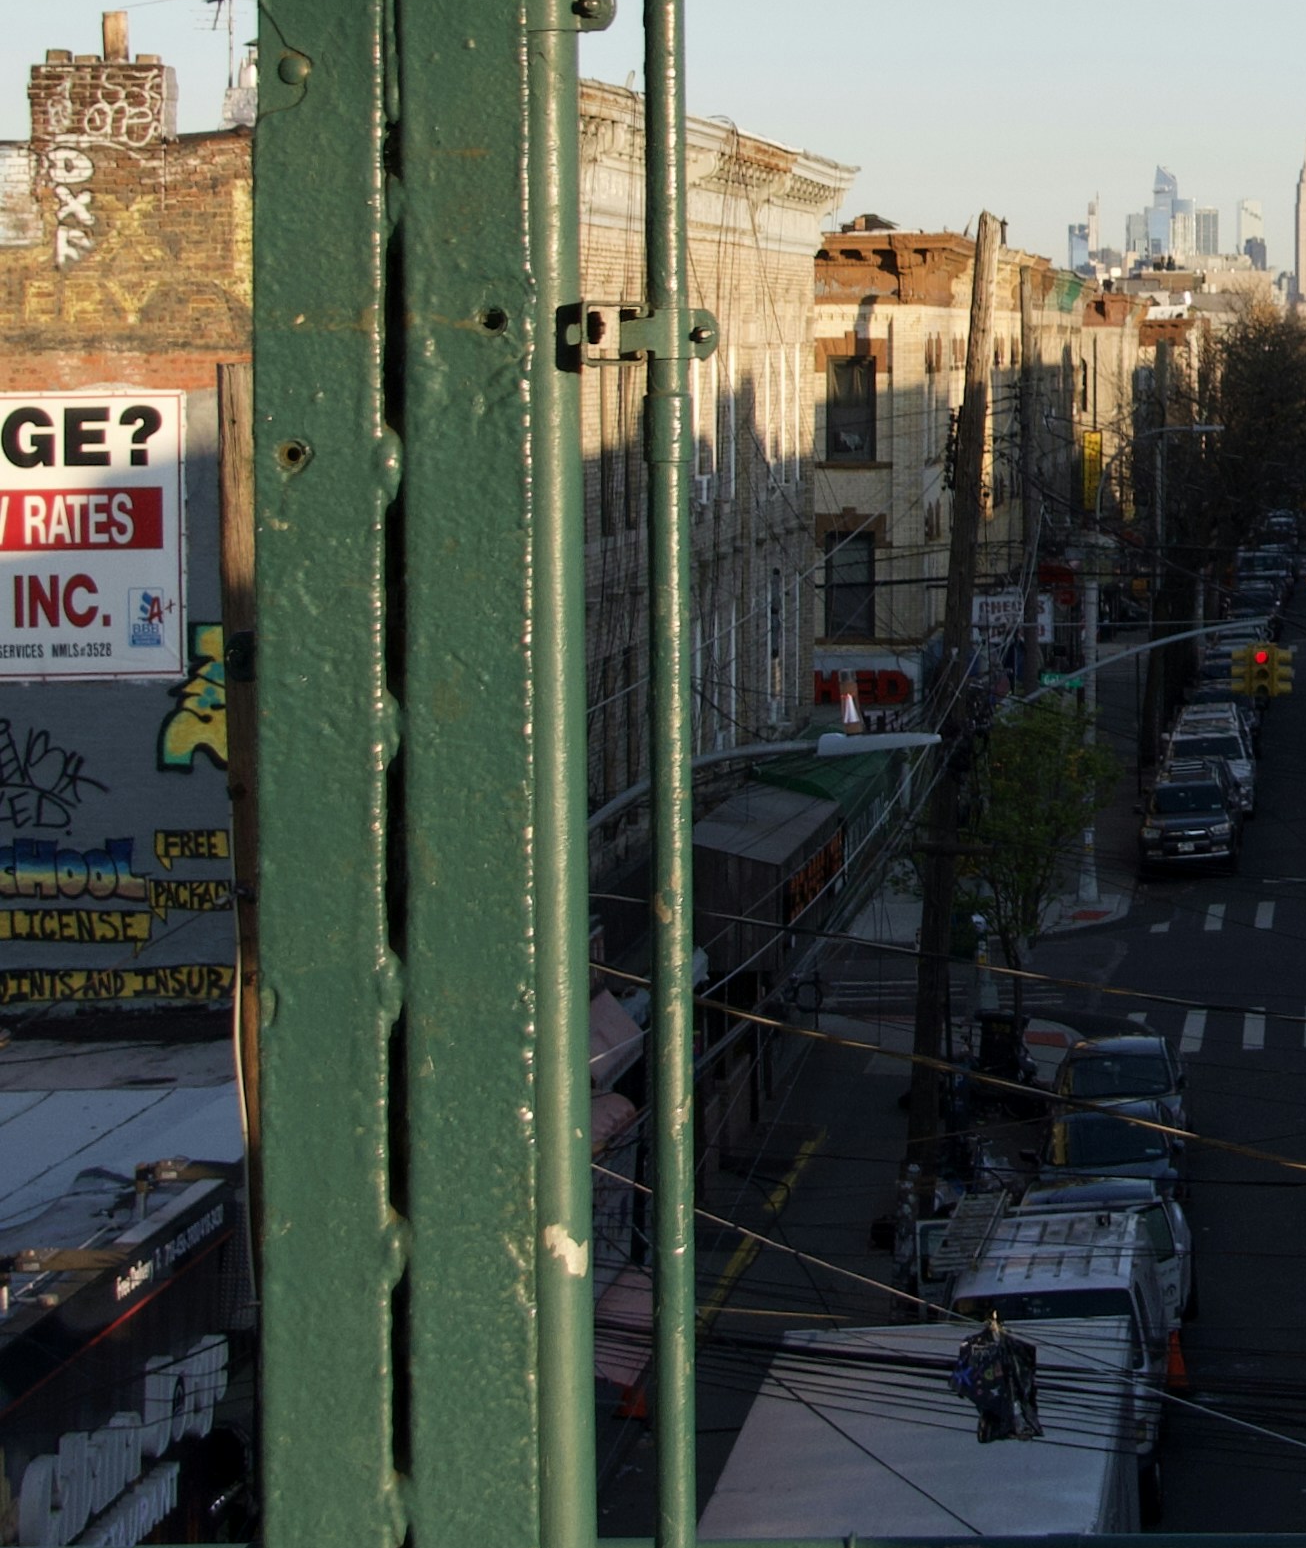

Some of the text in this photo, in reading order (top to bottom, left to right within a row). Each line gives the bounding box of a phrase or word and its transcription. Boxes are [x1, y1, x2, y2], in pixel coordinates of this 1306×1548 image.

[24, 492, 134, 545] RATES
[14, 573, 112, 628] INC.
[132, 623, 159, 634] BBB
[52, 642, 113, 658] NMLS#3528
[164, 833, 219, 857] FREE
[12, 910, 137, 941] LICENSE
[85, 969, 126, 999] AND
